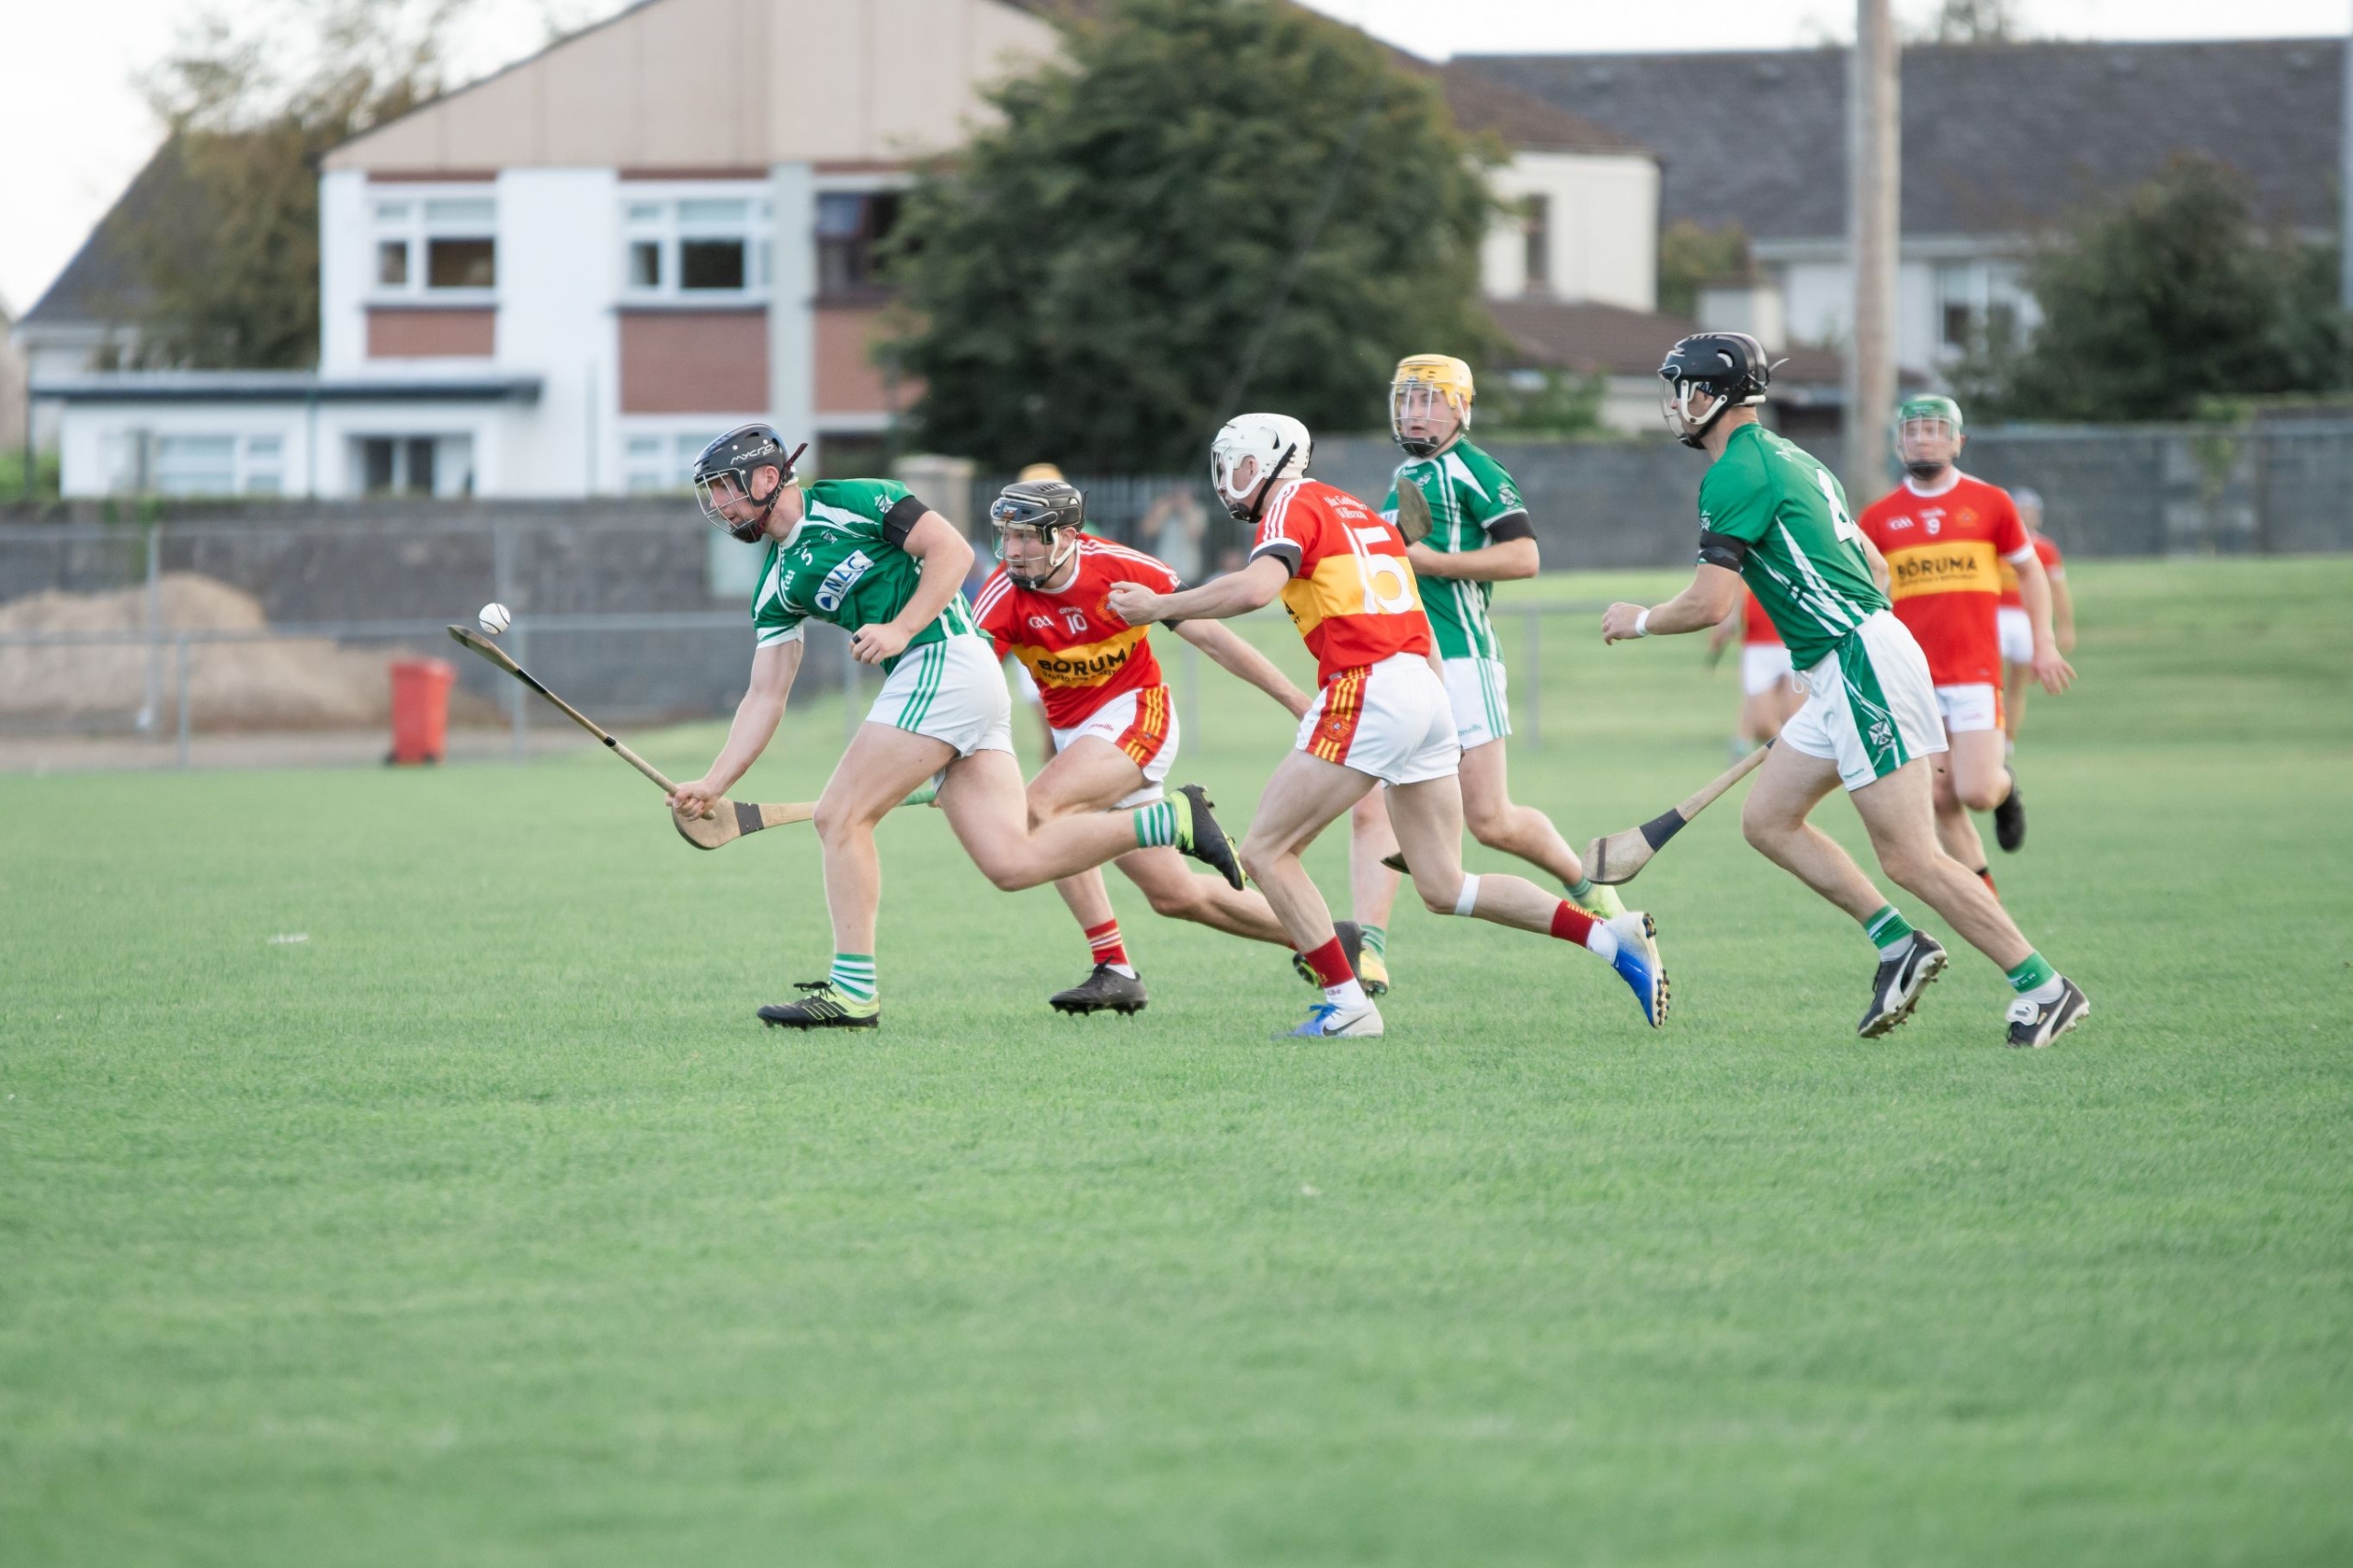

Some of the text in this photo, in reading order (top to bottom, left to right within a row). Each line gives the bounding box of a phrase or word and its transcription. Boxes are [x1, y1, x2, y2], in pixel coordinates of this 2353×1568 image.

[731, 444, 774, 464] mycro
[1927, 517, 1940, 535] 9
[801, 548, 813, 566] 5
[1342, 522, 1415, 614] 15
[1066, 613, 1088, 634] 10
